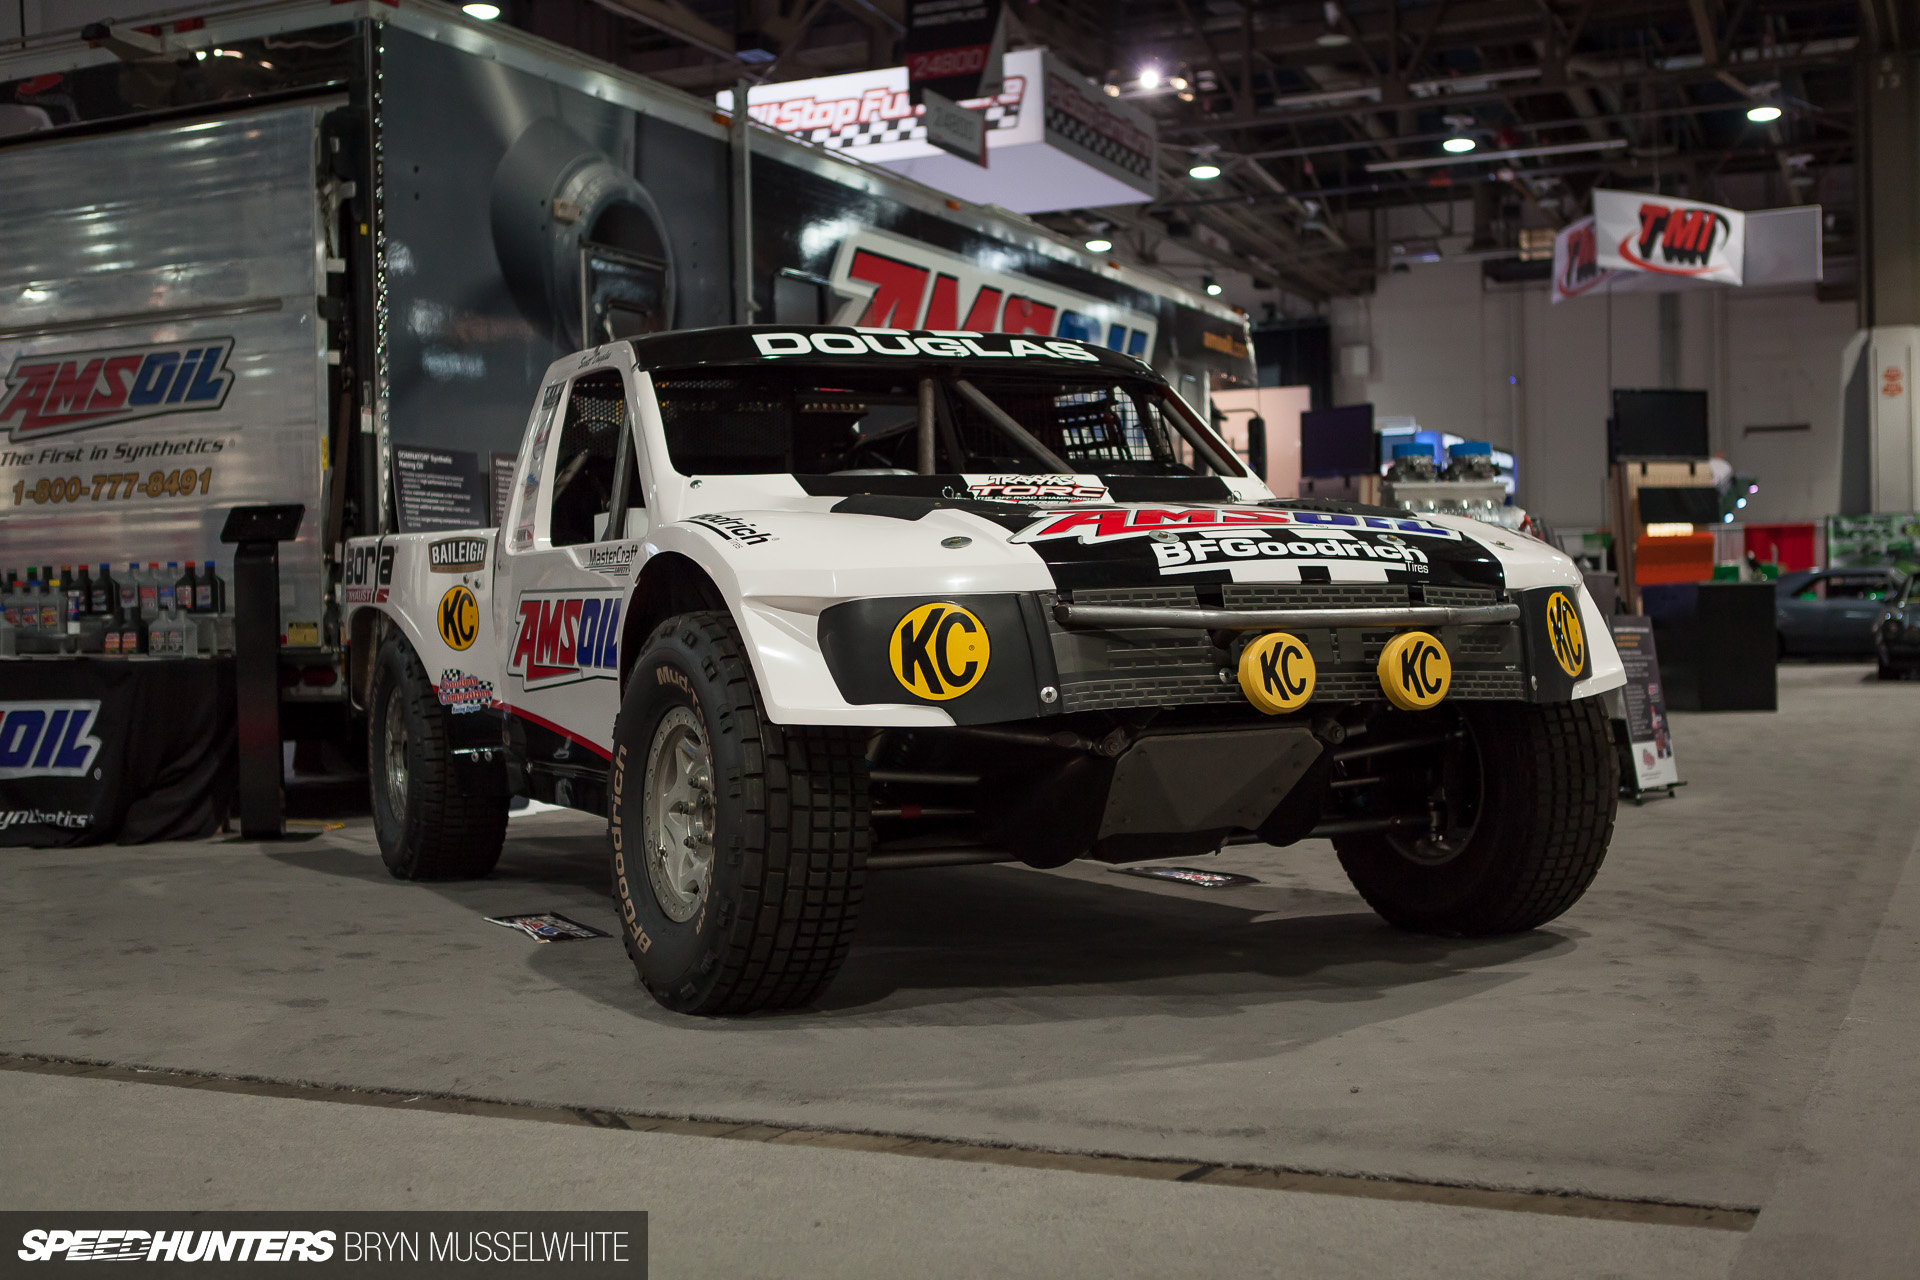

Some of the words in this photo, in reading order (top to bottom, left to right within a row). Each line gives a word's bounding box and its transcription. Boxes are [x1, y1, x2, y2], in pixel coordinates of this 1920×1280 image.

[914, 49, 984, 77] 24800
[1639, 203, 1718, 266] TMI
[751, 333, 1099, 361] DOUGLAS
[0, 346, 223, 432] AMSOIL
[1, 452, 33, 467] The
[38, 448, 82, 464] First
[90, 445, 108, 461] in
[113, 438, 224, 463] Synthetics
[398, 460, 416, 471] Racing
[12, 467, 212, 506] 1-800-777-8491
[971, 485, 1108, 498] TORC
[988, 475, 1077, 485] TRAXXAS
[1036, 509, 1451, 537] AMSOIL
[432, 541, 485, 565] BAILEIGH
[589, 544, 639, 566] MasterCraft
[1150, 538, 1429, 568] BFGoodrich
[1405, 560, 1429, 574] Tires
[443, 590, 475, 647] KC
[513, 598, 622, 682] AMSOIL
[1549, 596, 1582, 672] KC
[901, 608, 978, 694] KC
[441, 674, 479, 691] Goodwin
[1260, 641, 1306, 701] KC
[1401, 641, 1442, 699] KC
[440, 688, 491, 705] Competition
[0, 709, 92, 769] OIL
[611, 744, 652, 954] BFGoodrich
